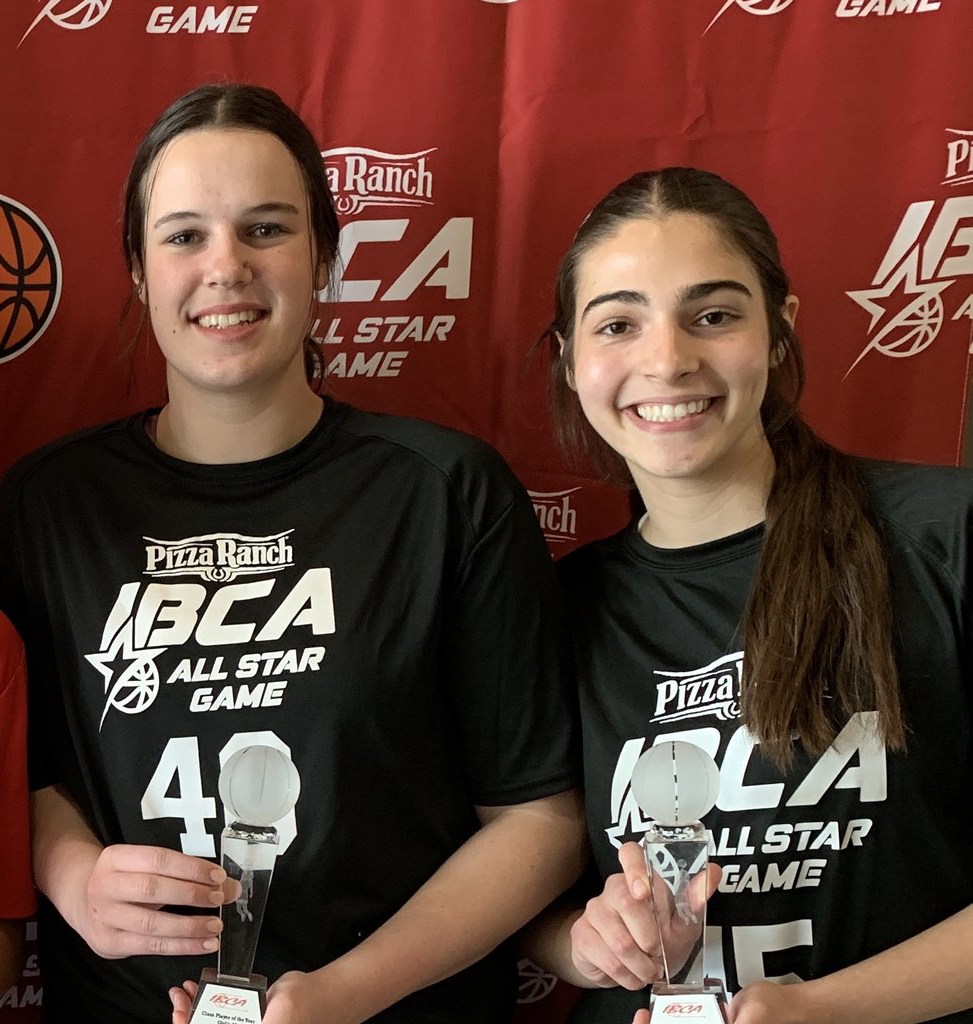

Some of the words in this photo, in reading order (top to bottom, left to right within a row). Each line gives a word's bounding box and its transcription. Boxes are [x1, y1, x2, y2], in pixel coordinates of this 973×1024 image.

[145, 6, 258, 34] GAME
[344, 156, 433, 198] Ranch
[872, 195, 973, 286] IB
[315, 217, 474, 303] CA
[353, 315, 456, 343] STAR
[533, 496, 577, 534] nch
[145, 544, 214, 571] Pizza
[216, 538, 294, 568] Ranch
[99, 567, 336, 652] IBCA
[167, 656, 229, 684] ALL
[235, 646, 326, 679] STAR
[189, 680, 288, 713] GAME
[654, 674, 733, 717] Pizza
[761, 818, 873, 855] STAR
[717, 858, 827, 894] GAME
